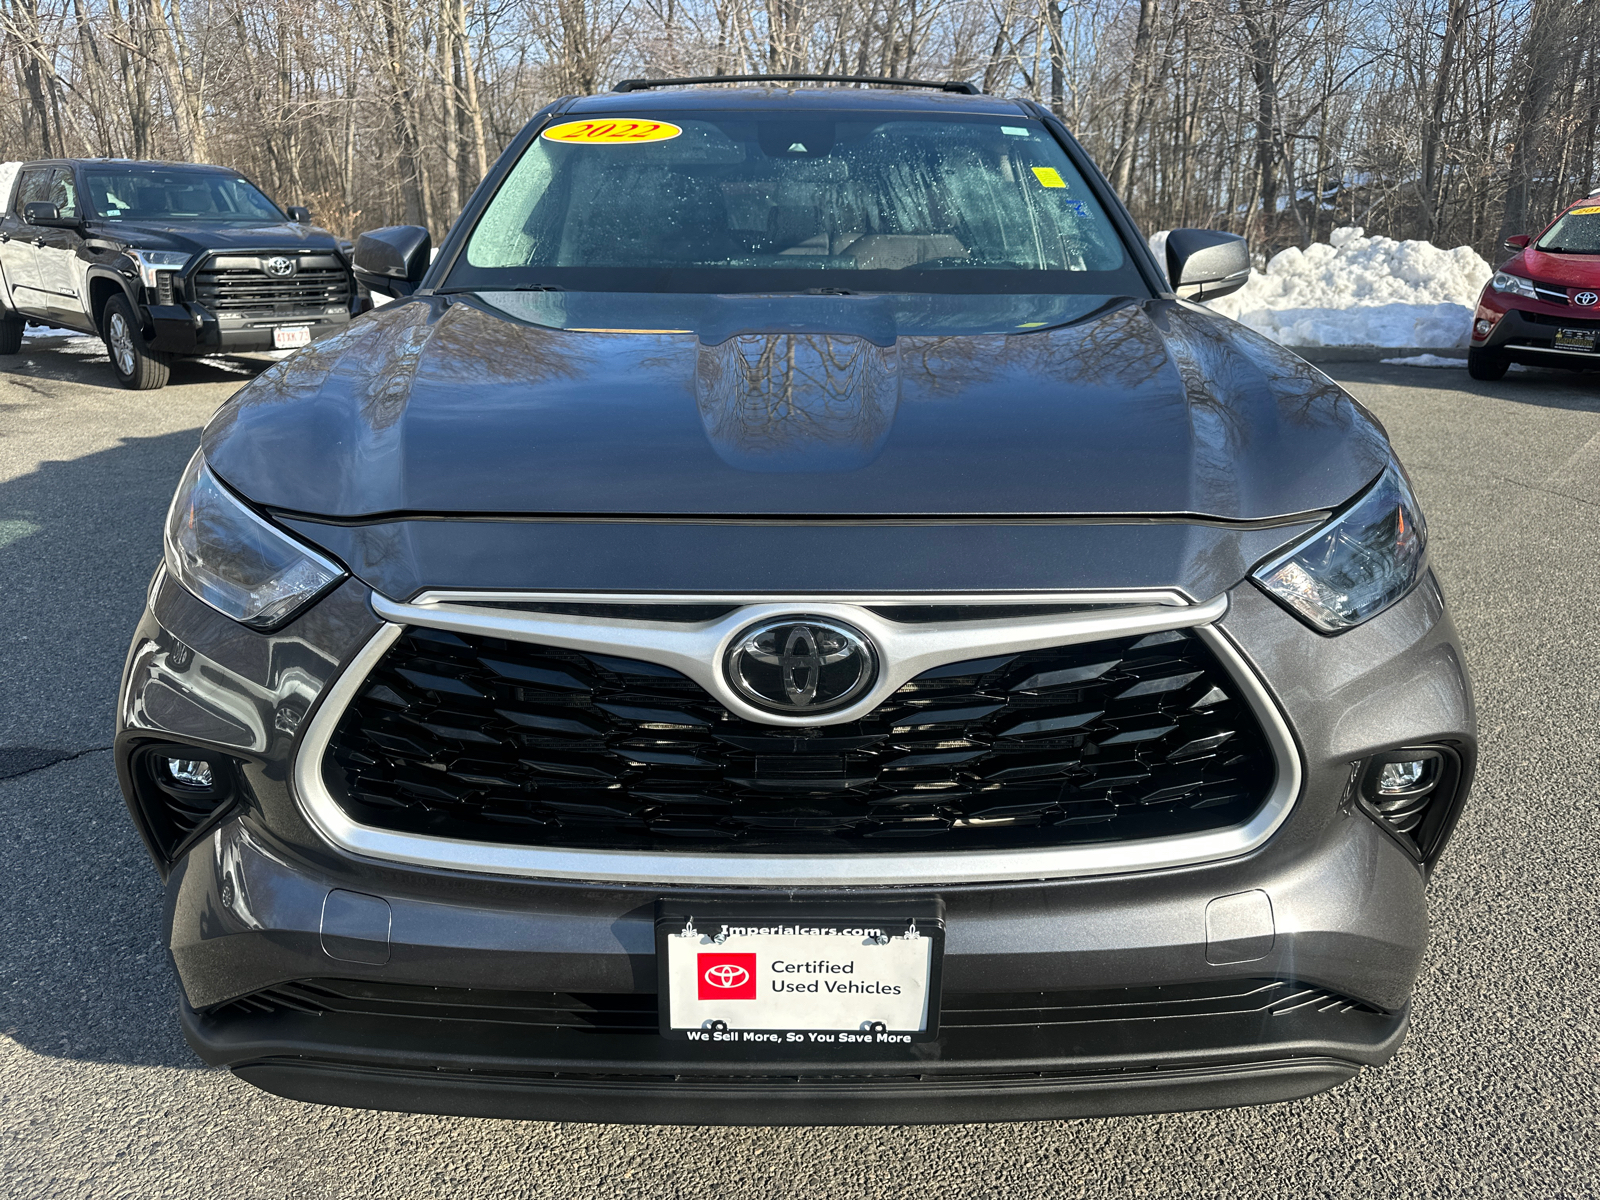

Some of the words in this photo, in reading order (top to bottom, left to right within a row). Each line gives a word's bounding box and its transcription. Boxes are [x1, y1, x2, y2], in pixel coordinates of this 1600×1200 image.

[561, 124, 661, 138] 2022
[299, 331, 310, 341] 73
[720, 924, 881, 937] Imperialcars.com
[771, 960, 854, 974] Certified
[772, 980, 818, 993] Used
[824, 980, 902, 995] Vehicles
[687, 1031, 709, 1041] We
[713, 1031, 739, 1041] Sell
[743, 1032, 782, 1043] More,
[786, 1032, 804, 1042] So
[808, 1032, 835, 1043] You
[838, 1032, 872, 1043] Save
[876, 1033, 912, 1043] More
